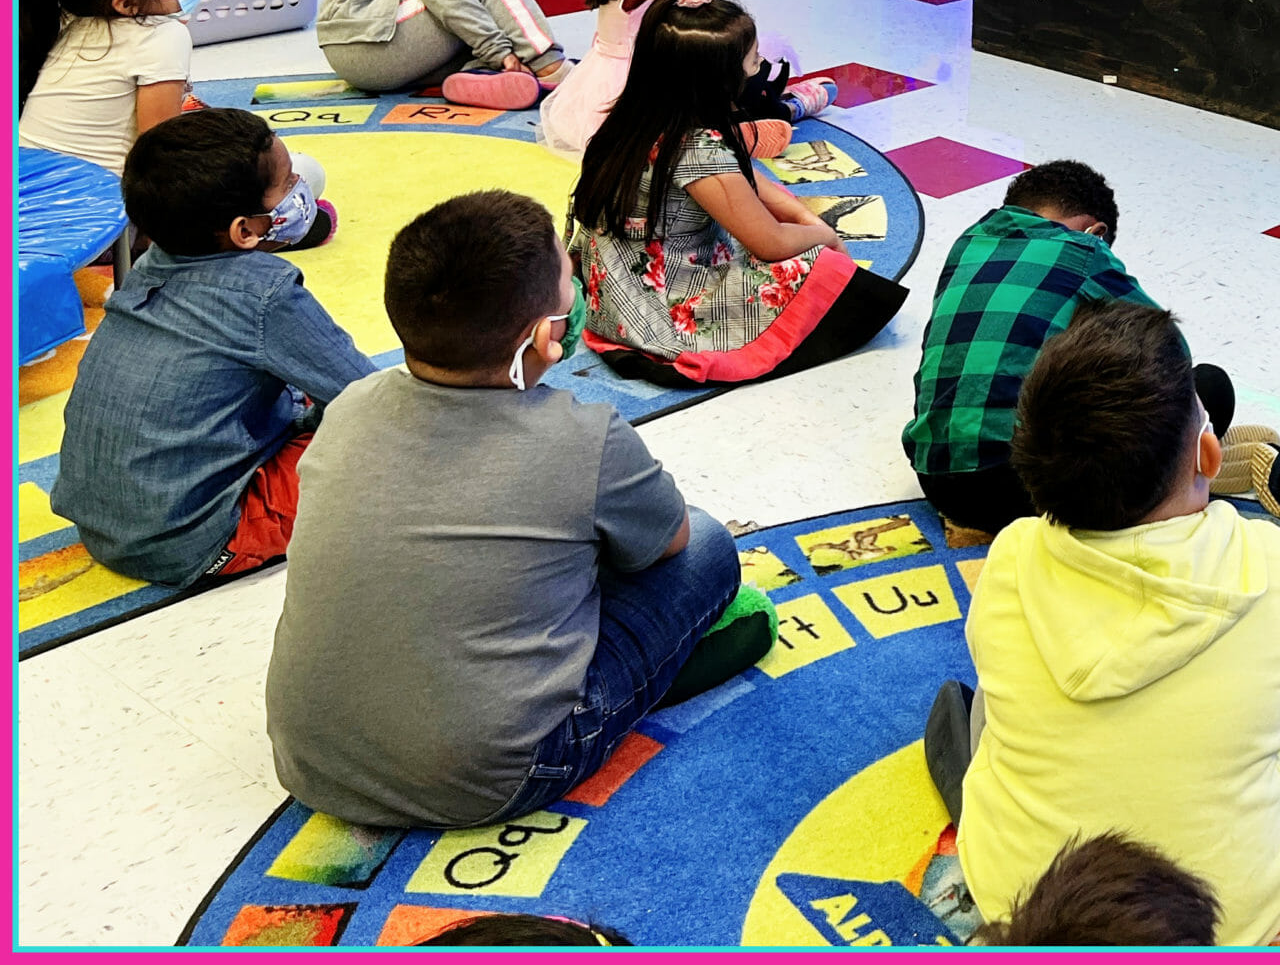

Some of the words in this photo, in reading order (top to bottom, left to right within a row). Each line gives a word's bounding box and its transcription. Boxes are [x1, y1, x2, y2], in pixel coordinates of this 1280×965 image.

[268, 109, 353, 125] Qq
[408, 106, 471, 120] Rr
[863, 585, 940, 615] Uu
